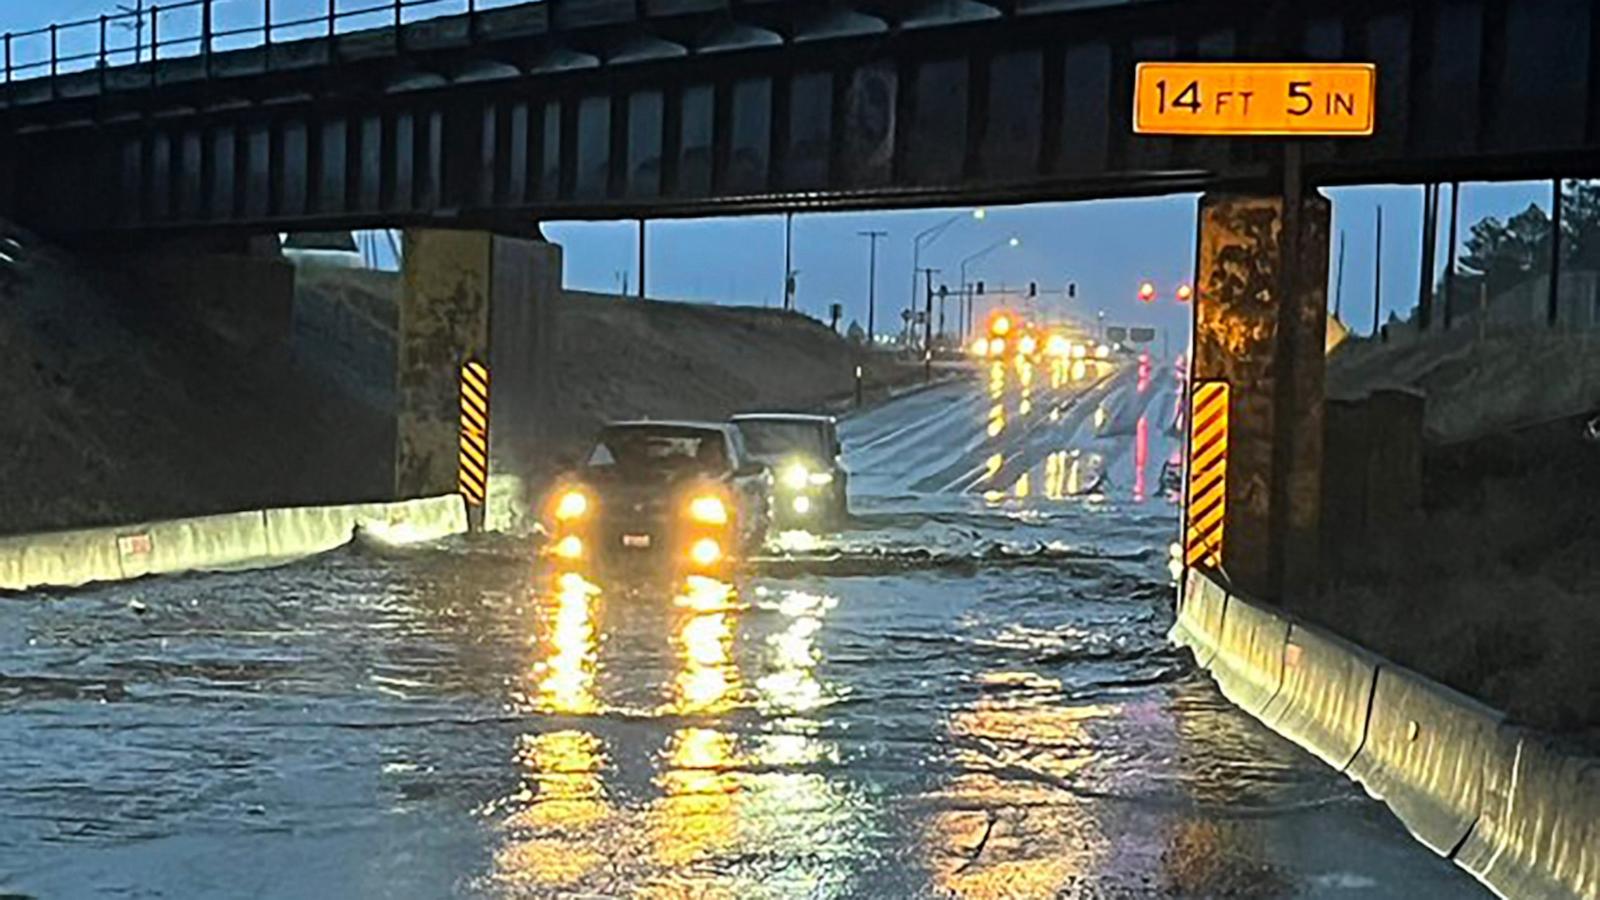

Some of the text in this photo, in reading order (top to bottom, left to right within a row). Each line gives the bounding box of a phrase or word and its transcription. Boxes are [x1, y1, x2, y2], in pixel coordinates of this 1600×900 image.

[1156, 80, 1354, 116] 14 FT 5 IN
